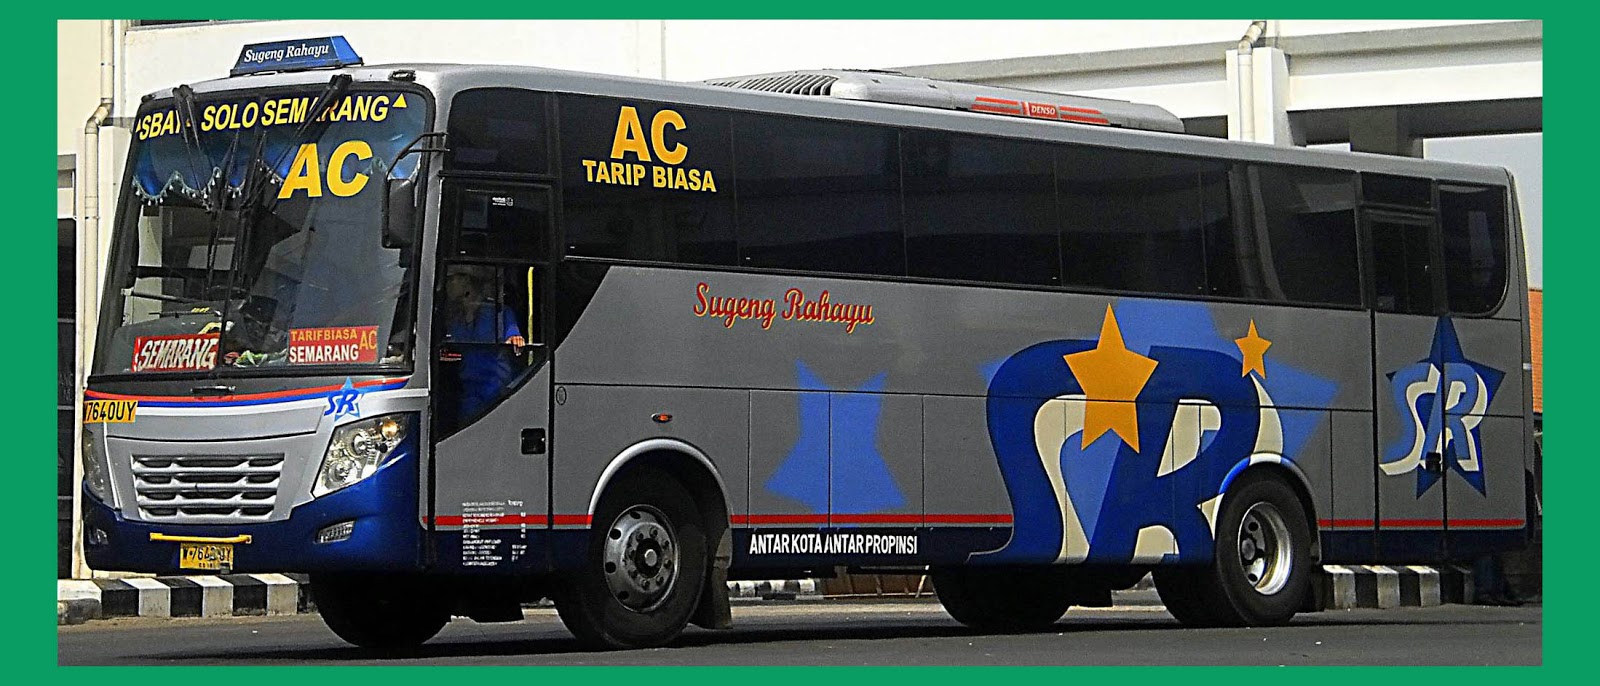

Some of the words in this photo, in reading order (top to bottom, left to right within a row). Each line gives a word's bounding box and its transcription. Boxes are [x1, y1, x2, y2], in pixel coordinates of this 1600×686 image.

[243, 48, 284, 63] Sugeng
[285, 43, 329, 58] Rahayu
[201, 102, 259, 132] SOLO
[1031, 105, 1056, 115] DENSO
[610, 105, 689, 165] AC
[277, 140, 373, 199] AC
[582, 159, 646, 186] TARIP
[652, 165, 717, 192] BIASA
[693, 282, 776, 330] Sugeng
[781, 288, 876, 333] Rahayu
[136, 338, 220, 371] SEMARANG
[289, 343, 359, 363] SEMARANG
[359, 329, 378, 351] AC
[323, 389, 361, 417] SR
[749, 534, 790, 554] ANTAR
[791, 533, 823, 554] KOTA
[824, 533, 864, 554] ANTAR
[865, 534, 918, 554] PROPINSI
